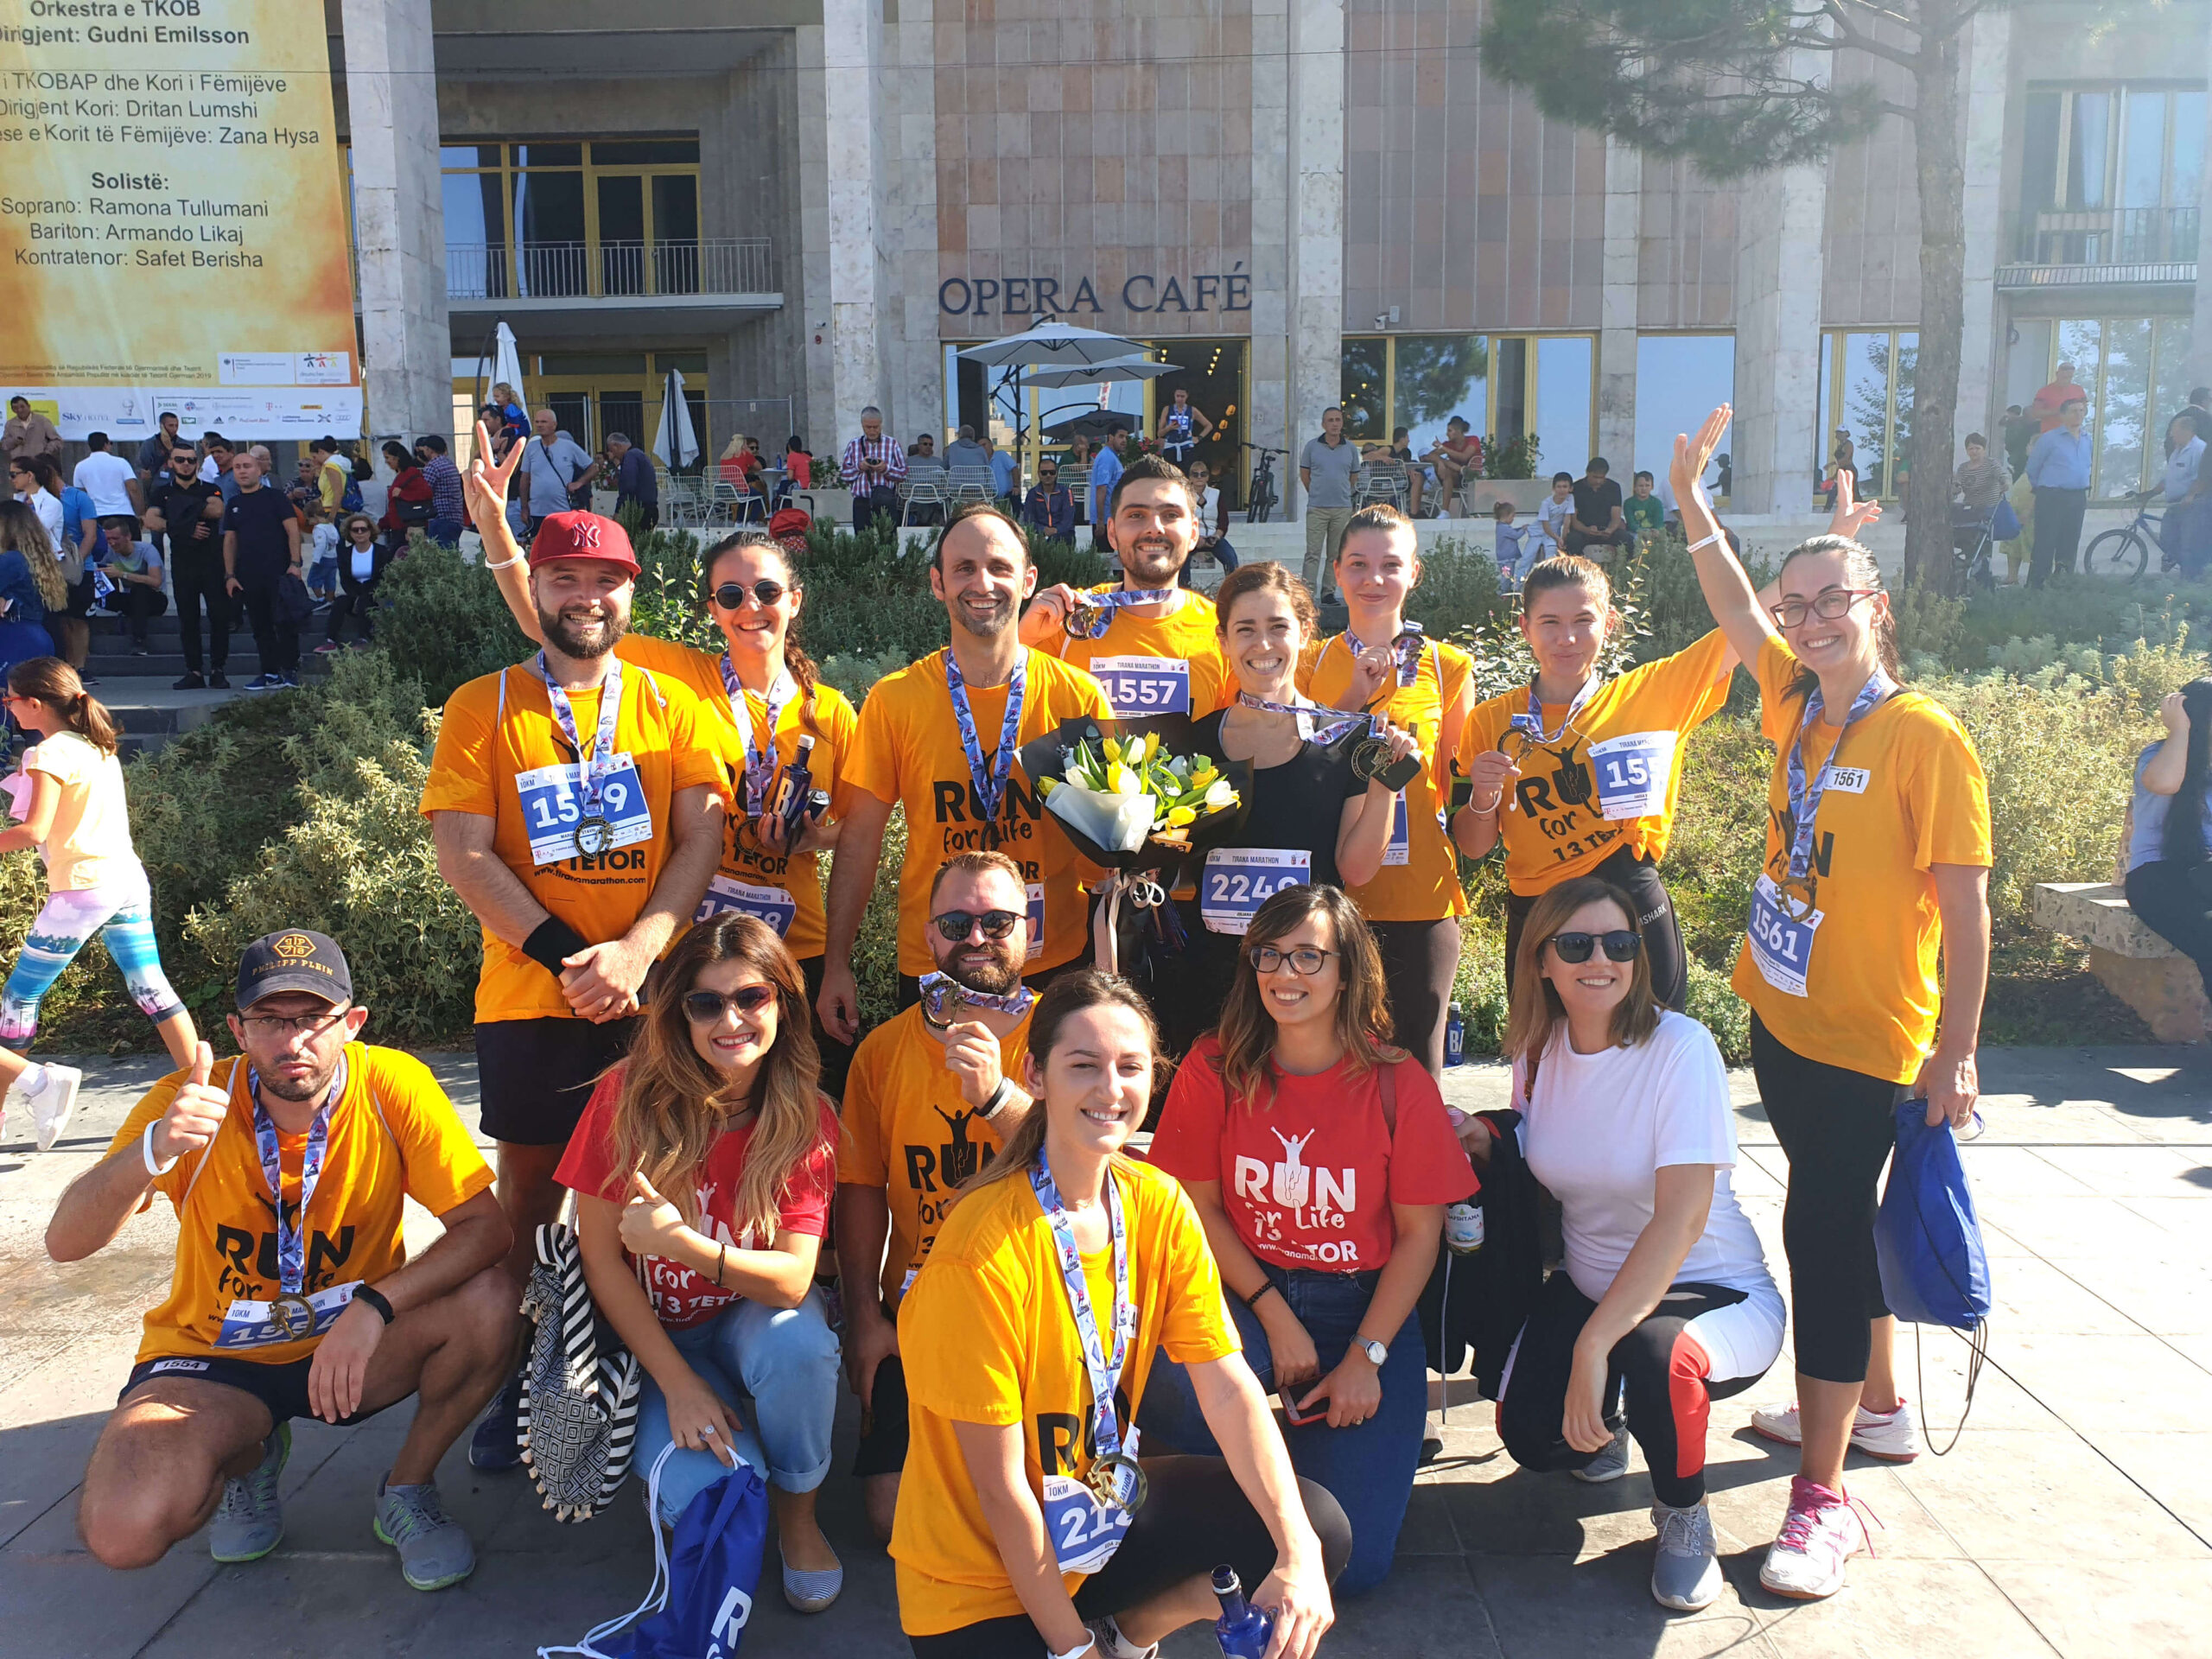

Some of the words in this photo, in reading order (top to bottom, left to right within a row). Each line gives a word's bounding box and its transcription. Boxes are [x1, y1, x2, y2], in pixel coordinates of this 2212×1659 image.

[30, 0, 118, 16] Orkestra
[124, 3, 135, 16] e
[141, 0, 201, 16] TKOB
[0, 25, 79, 46] irigjent:
[87, 26, 148, 43] Gudni
[156, 27, 250, 44] Emilsson
[3, 73, 7, 90] i
[12, 73, 98, 91] TKOBAP
[105, 74, 139, 91] dhe
[146, 74, 185, 92] Kori
[189, 75, 194, 92] i
[200, 75, 288, 96] Fëmijëve
[75, 101, 119, 118] Kori:
[126, 101, 182, 118] Dritan
[189, 101, 258, 118] Lumshi
[0, 129, 22, 142] se
[29, 128, 41, 141] e
[44, 124, 90, 142] Korit
[96, 125, 113, 143] të
[121, 126, 213, 148] Fëmijëve:
[219, 127, 268, 145] Zana
[274, 128, 320, 149] Hysa
[92, 173, 169, 191] Solistë:
[2, 198, 82, 219] Soprano:
[90, 199, 172, 217] Ramona
[177, 200, 269, 218] Tullumani
[31, 224, 100, 240] Bariton:
[105, 225, 194, 242] Armando
[200, 225, 245, 246] Likaj
[15, 249, 128, 266] Kontratenor:
[135, 250, 186, 267] Safet
[193, 251, 264, 268] Berisha
[938, 276, 1104, 315] OPERA
[1122, 260, 1253, 313] CAFÉ
[62, 412, 82, 422] Sky
[1101, 678, 1177, 704] 1557
[520, 779, 535, 788] 10KM
[1834, 772, 1863, 788] 1561
[532, 783, 628, 829] 159
[933, 779, 1042, 823] RUN
[1540, 810, 1577, 840] for
[944, 826, 978, 854] for
[1250, 855, 1280, 864] MARATHON
[534, 865, 646, 885] www.tiranamarathon.com
[728, 886, 746, 898] TIRANA
[746, 890, 772, 902] MARATHON
[1752, 902, 1798, 963] 1561
[251, 959, 297, 976] PHILIPP
[301, 958, 334, 976] PLEIN
[1235, 1154, 1356, 1213] RUN
[1293, 1199, 1345, 1230] Life
[216, 1223, 355, 1281] RUN
[219, 1265, 263, 1301] for
[655, 1262, 696, 1290] for
[653, 1291, 682, 1313] 13
[232, 1309, 251, 1319] 10KM
[162, 1360, 200, 1370] 1554
[1048, 1483, 1069, 1497] 10KM
